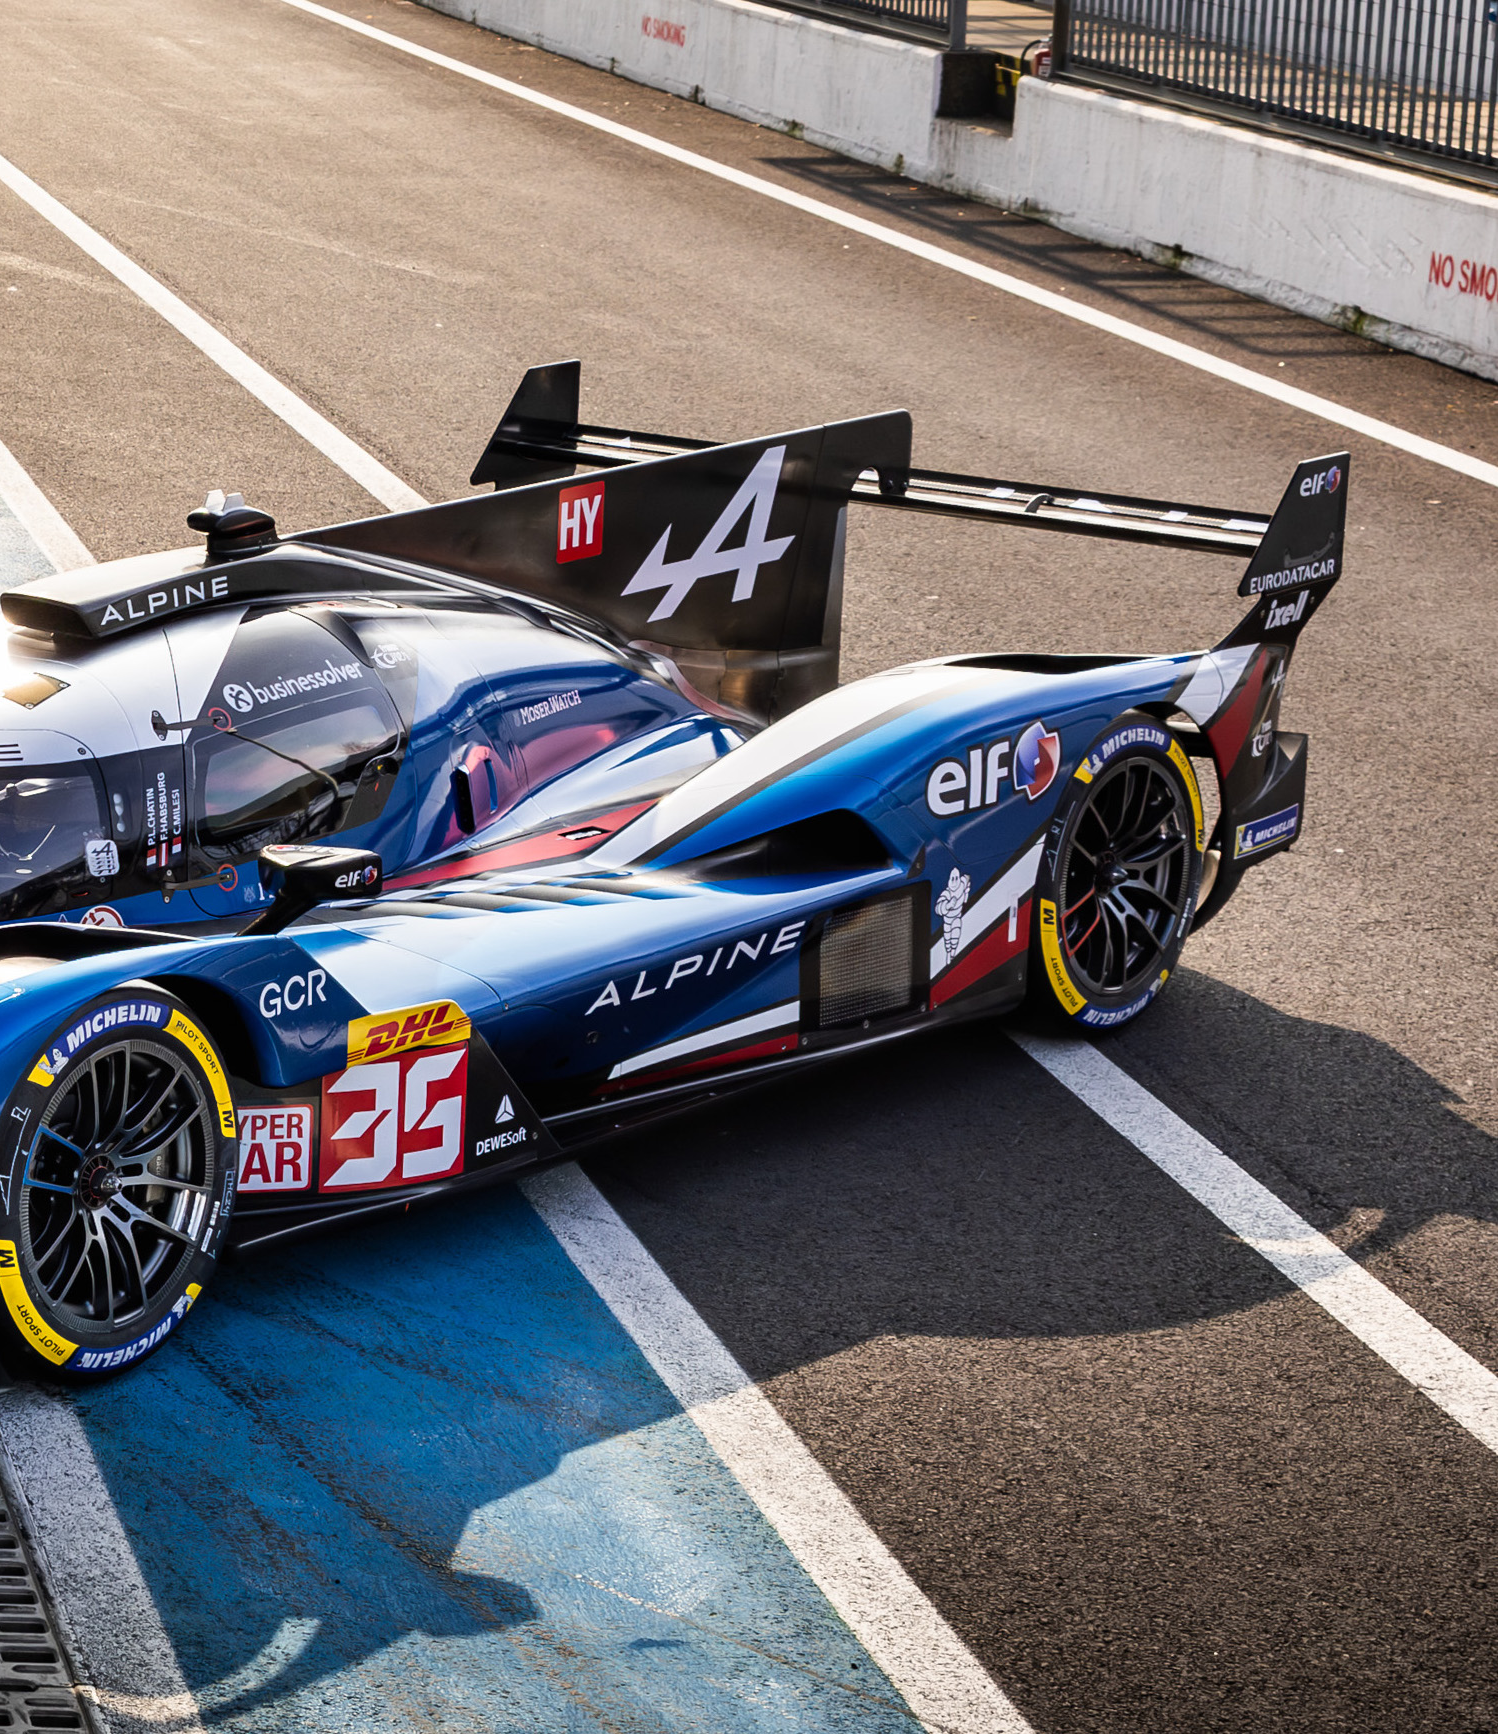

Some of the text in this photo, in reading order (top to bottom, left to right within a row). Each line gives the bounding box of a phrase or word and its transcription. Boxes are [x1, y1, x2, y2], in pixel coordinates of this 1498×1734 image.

[1429, 251, 1498, 301] NO SMO
[1299, 472, 1327, 497] elf
[559, 494, 602, 551] HY
[1250, 558, 1335, 594] EURODATACAR
[100, 575, 229, 626] ALPINE
[1264, 589, 1310, 630] ixell
[246, 659, 364, 704] businessolver
[1102, 727, 1165, 759] MICHELIN
[927, 738, 1011, 818] elf
[146, 787, 156, 847] P.L.CHATIN
[157, 771, 168, 842] F.HABSBURG
[172, 788, 181, 836] C.MILESI
[1254, 816, 1298, 843] MICHELIN
[334, 869, 362, 888] elf
[1043, 908, 1055, 925] M
[585, 921, 806, 1016] ALPINE
[259, 968, 327, 1018] GCR
[1083, 994, 1150, 1026] MICHELIN
[66, 1004, 162, 1053] MICHELIN
[175, 1019, 219, 1075] PILOT SPORT
[366, 1004, 456, 1053] DHL
[11, 1106, 29, 1122] FL
[222, 1110, 234, 1128] M
[238, 1113, 304, 1141] YPER
[324, 1048, 468, 1187] 35
[239, 1141, 303, 1185] AR
[475, 1127, 527, 1156] DEWESoft
[16, 1303, 66, 1358] PILOT SPORT
[77, 1316, 172, 1369] MICHELIN
